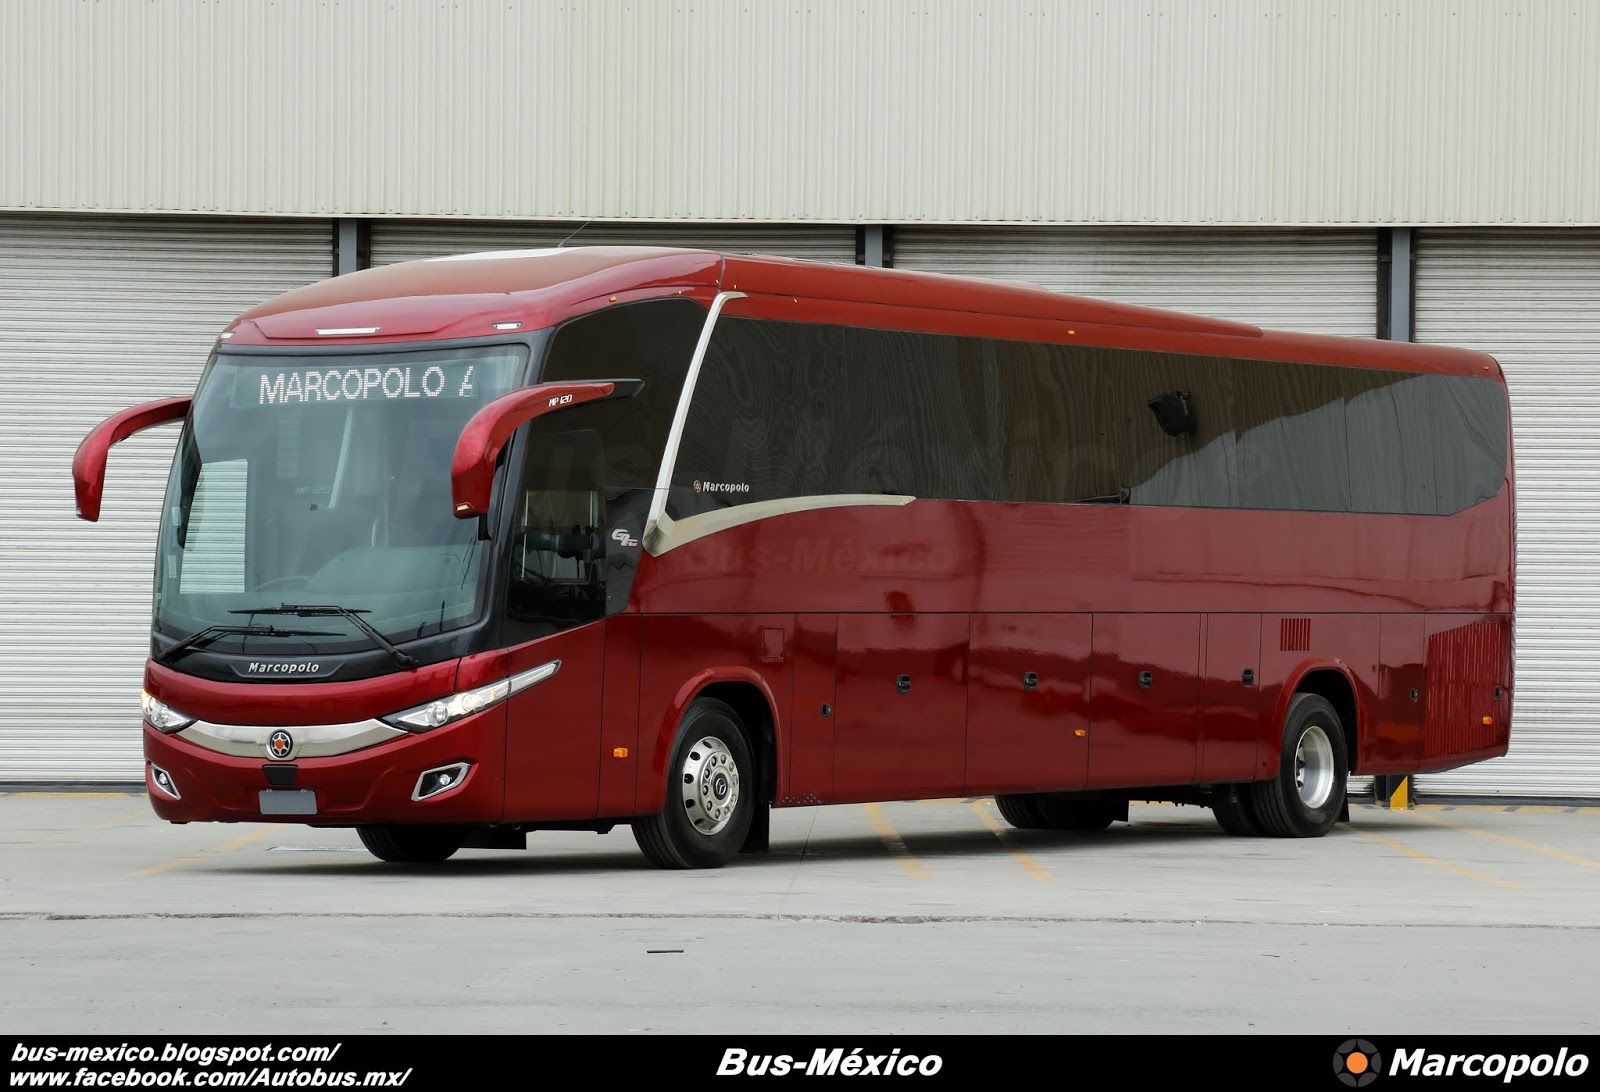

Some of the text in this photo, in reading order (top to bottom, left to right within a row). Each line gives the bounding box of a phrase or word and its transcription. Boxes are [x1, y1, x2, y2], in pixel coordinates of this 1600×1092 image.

[259, 366, 445, 405] MARCOPOLO
[560, 393, 573, 405] 120
[702, 481, 750, 494] Marcopolo
[248, 662, 320, 674] Marcopolo
